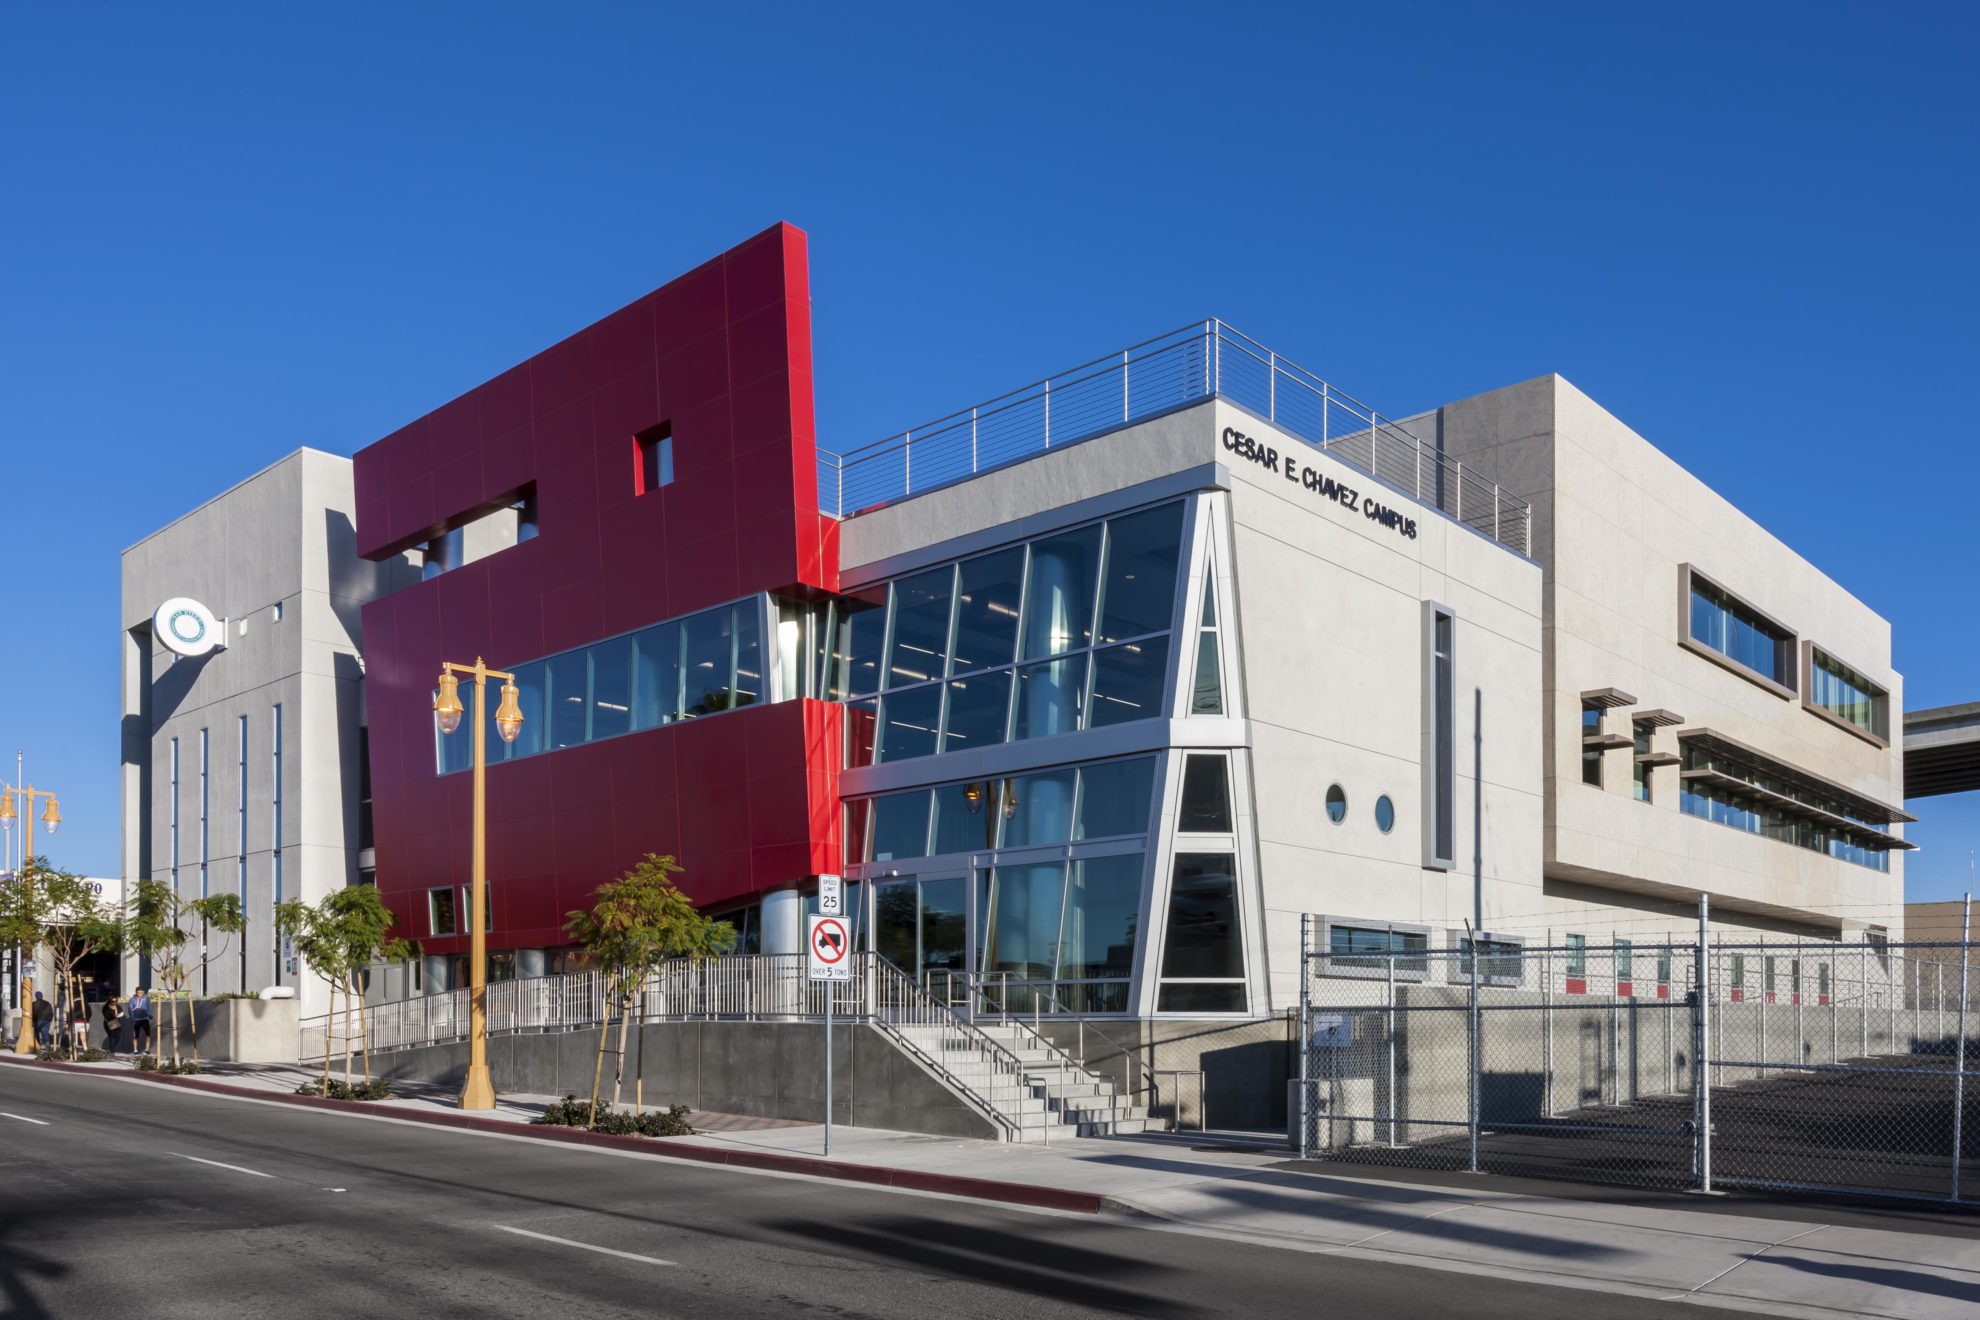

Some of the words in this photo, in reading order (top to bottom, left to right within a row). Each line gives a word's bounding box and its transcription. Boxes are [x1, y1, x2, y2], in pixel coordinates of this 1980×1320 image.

[1222, 427, 1278, 473] CESAR
[1285, 457, 1299, 483] E.
[1302, 467, 1359, 513] CHAVEZ
[1363, 498, 1417, 540] CAMPUS
[823, 896, 837, 908] 25
[827, 967, 832, 977] 5
